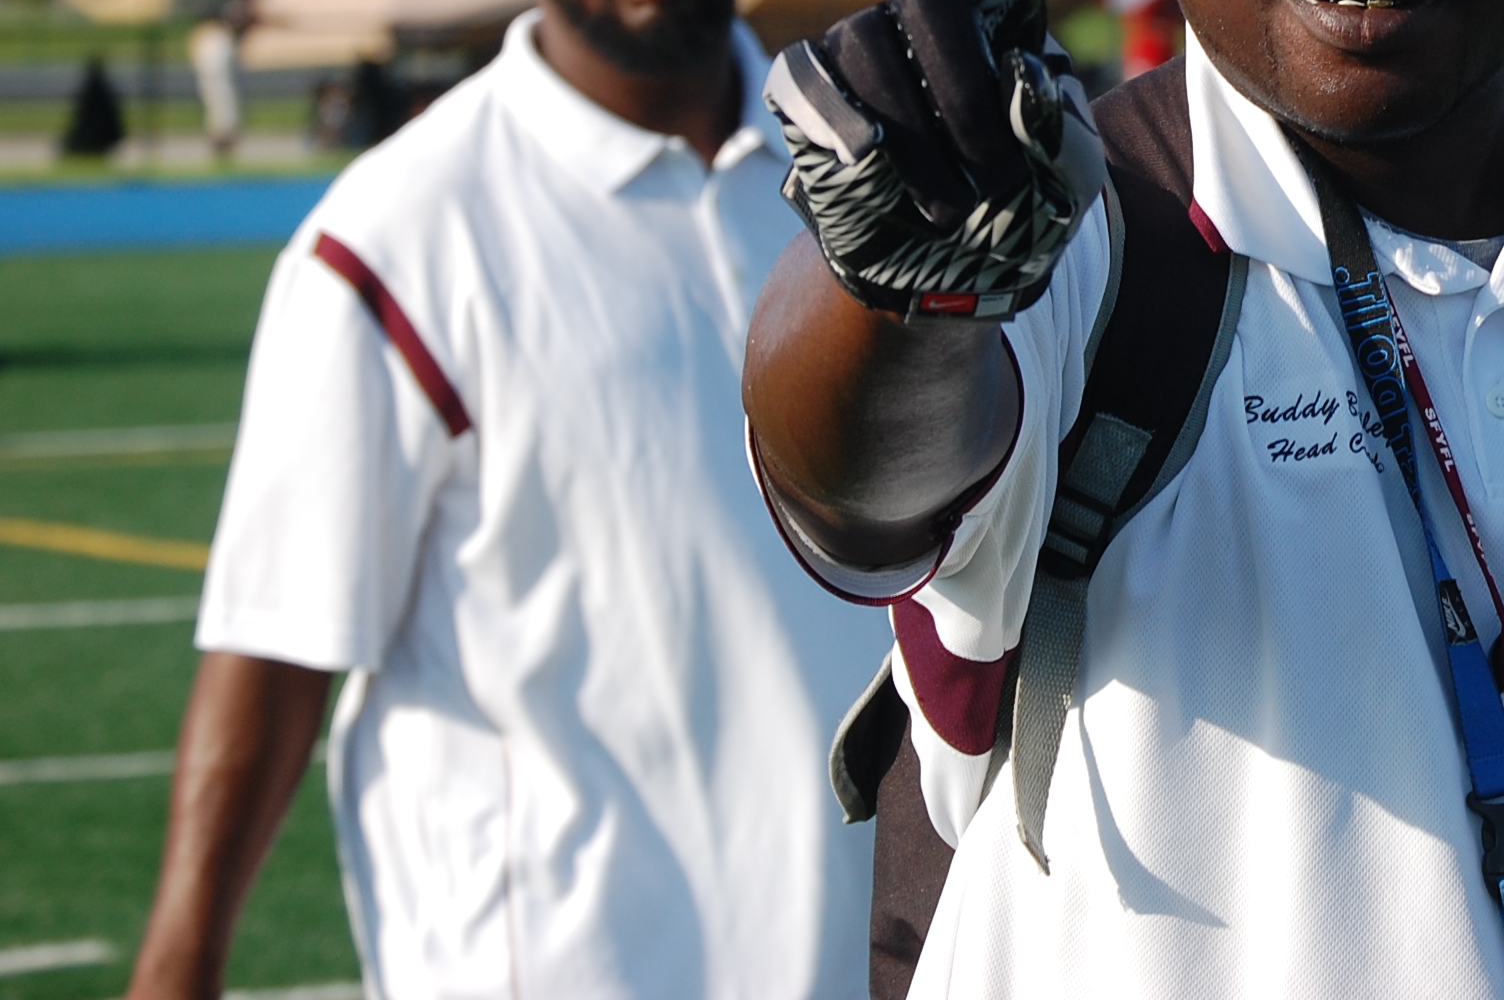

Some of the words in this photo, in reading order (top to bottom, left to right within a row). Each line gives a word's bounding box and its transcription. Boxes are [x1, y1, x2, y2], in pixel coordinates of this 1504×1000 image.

[1244, 389, 1340, 426] Buddy
[1267, 432, 1339, 463] Head
[1424, 407, 1455, 473] SFYFL
